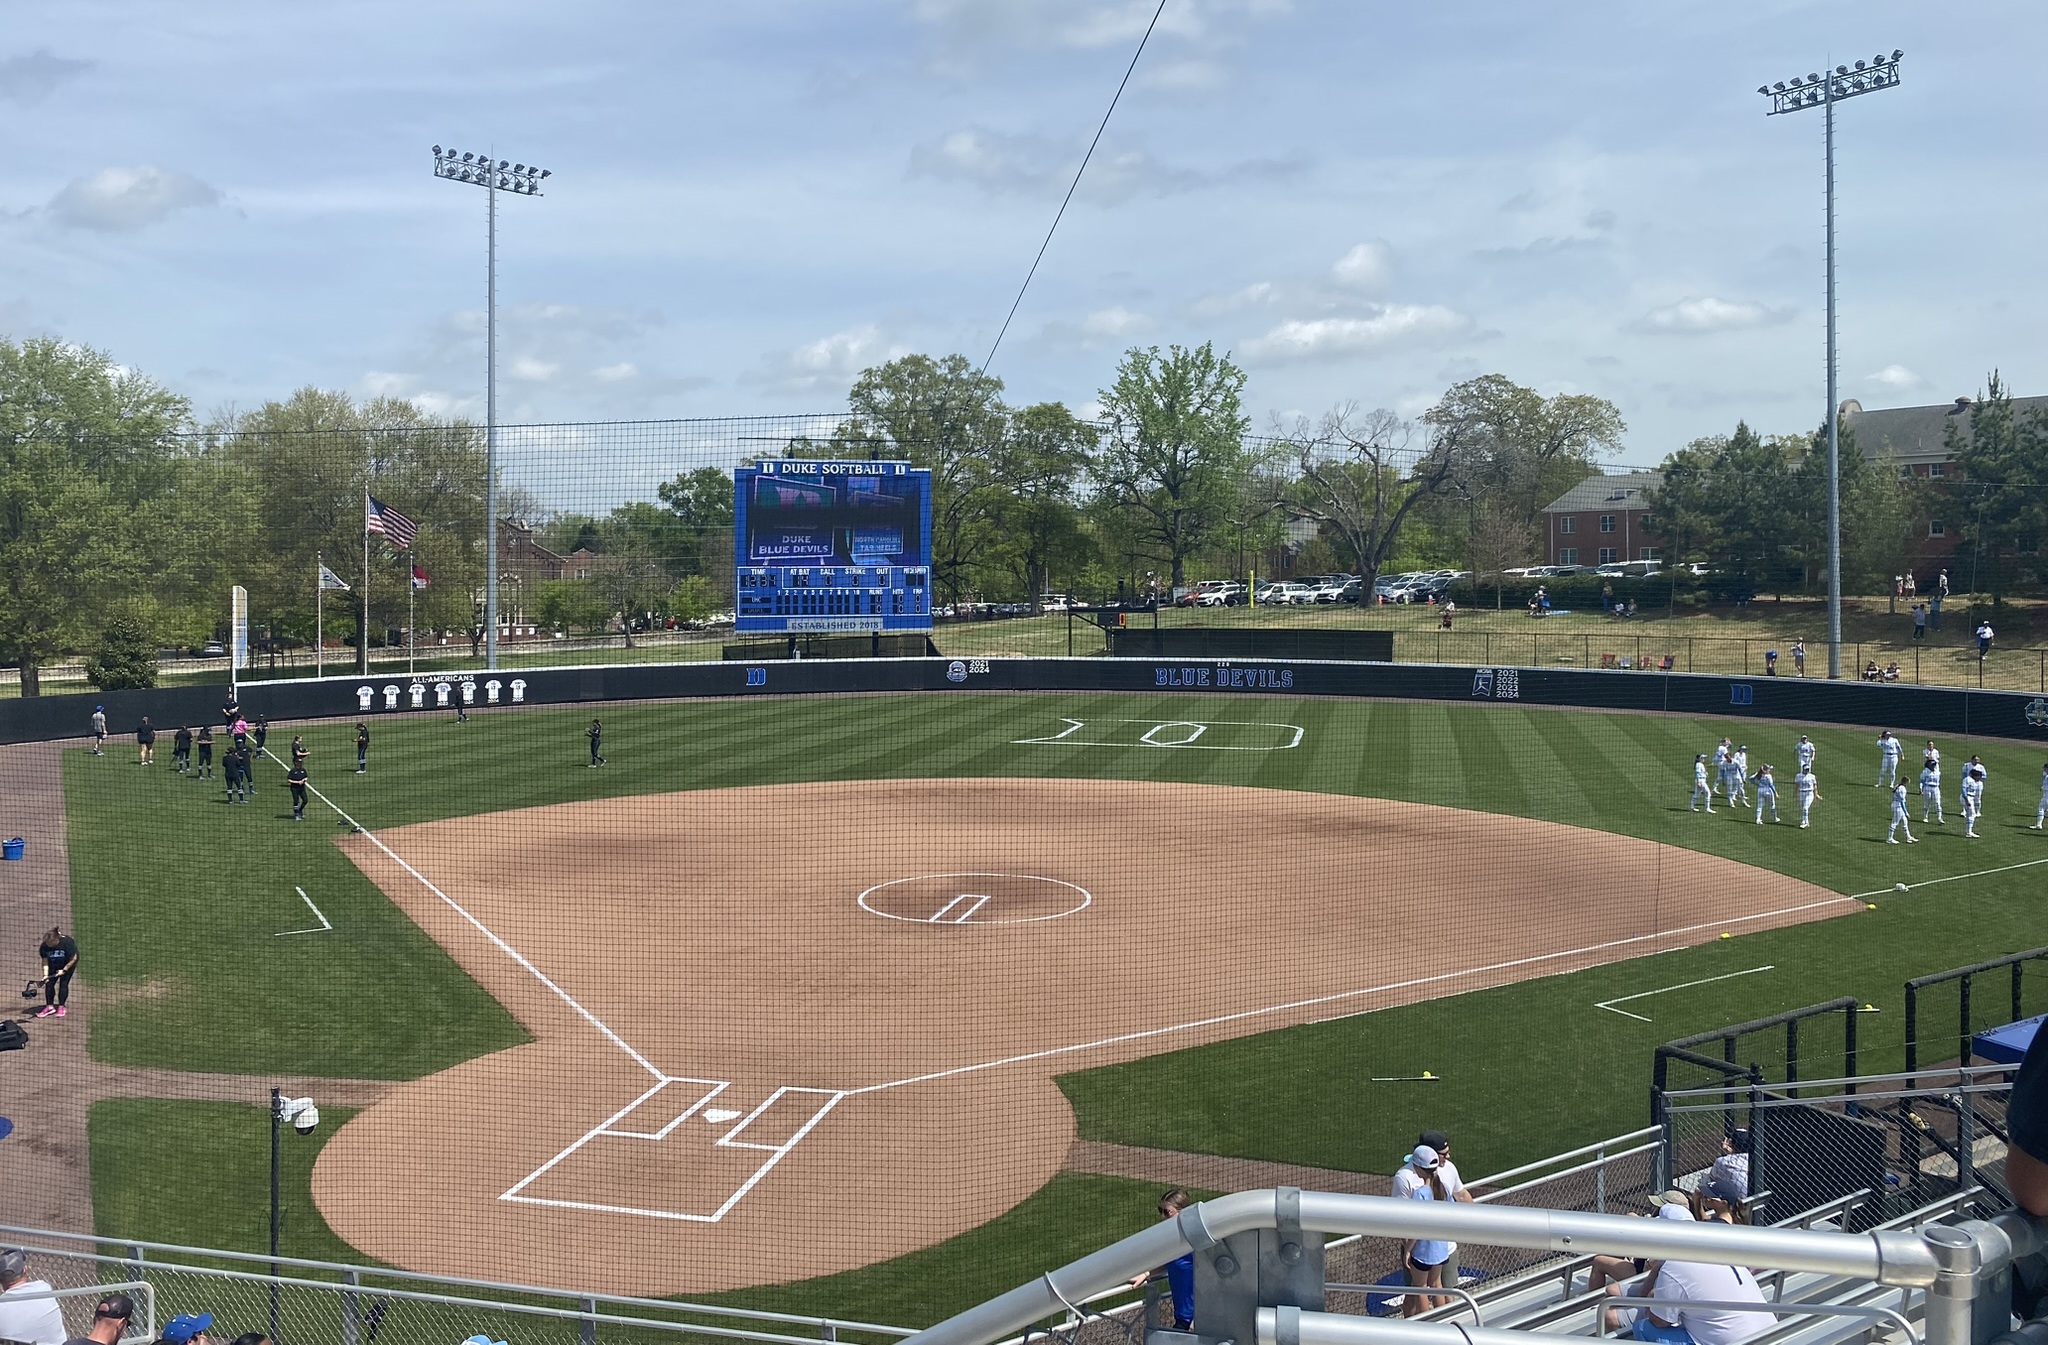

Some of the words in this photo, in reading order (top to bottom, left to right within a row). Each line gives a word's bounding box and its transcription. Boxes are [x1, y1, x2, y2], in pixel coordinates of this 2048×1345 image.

[782, 464, 818, 474] DUKE
[822, 464, 886, 474] SOFTBALL
[759, 546, 790, 554] BLUE
[852, 574, 858, 586] 0
[878, 574, 886, 586] 0
[412, 675, 474, 683] ALL-AMERICANS
[1156, 668, 1210, 686] BLUE
[1217, 668, 1293, 688] DEVILS
